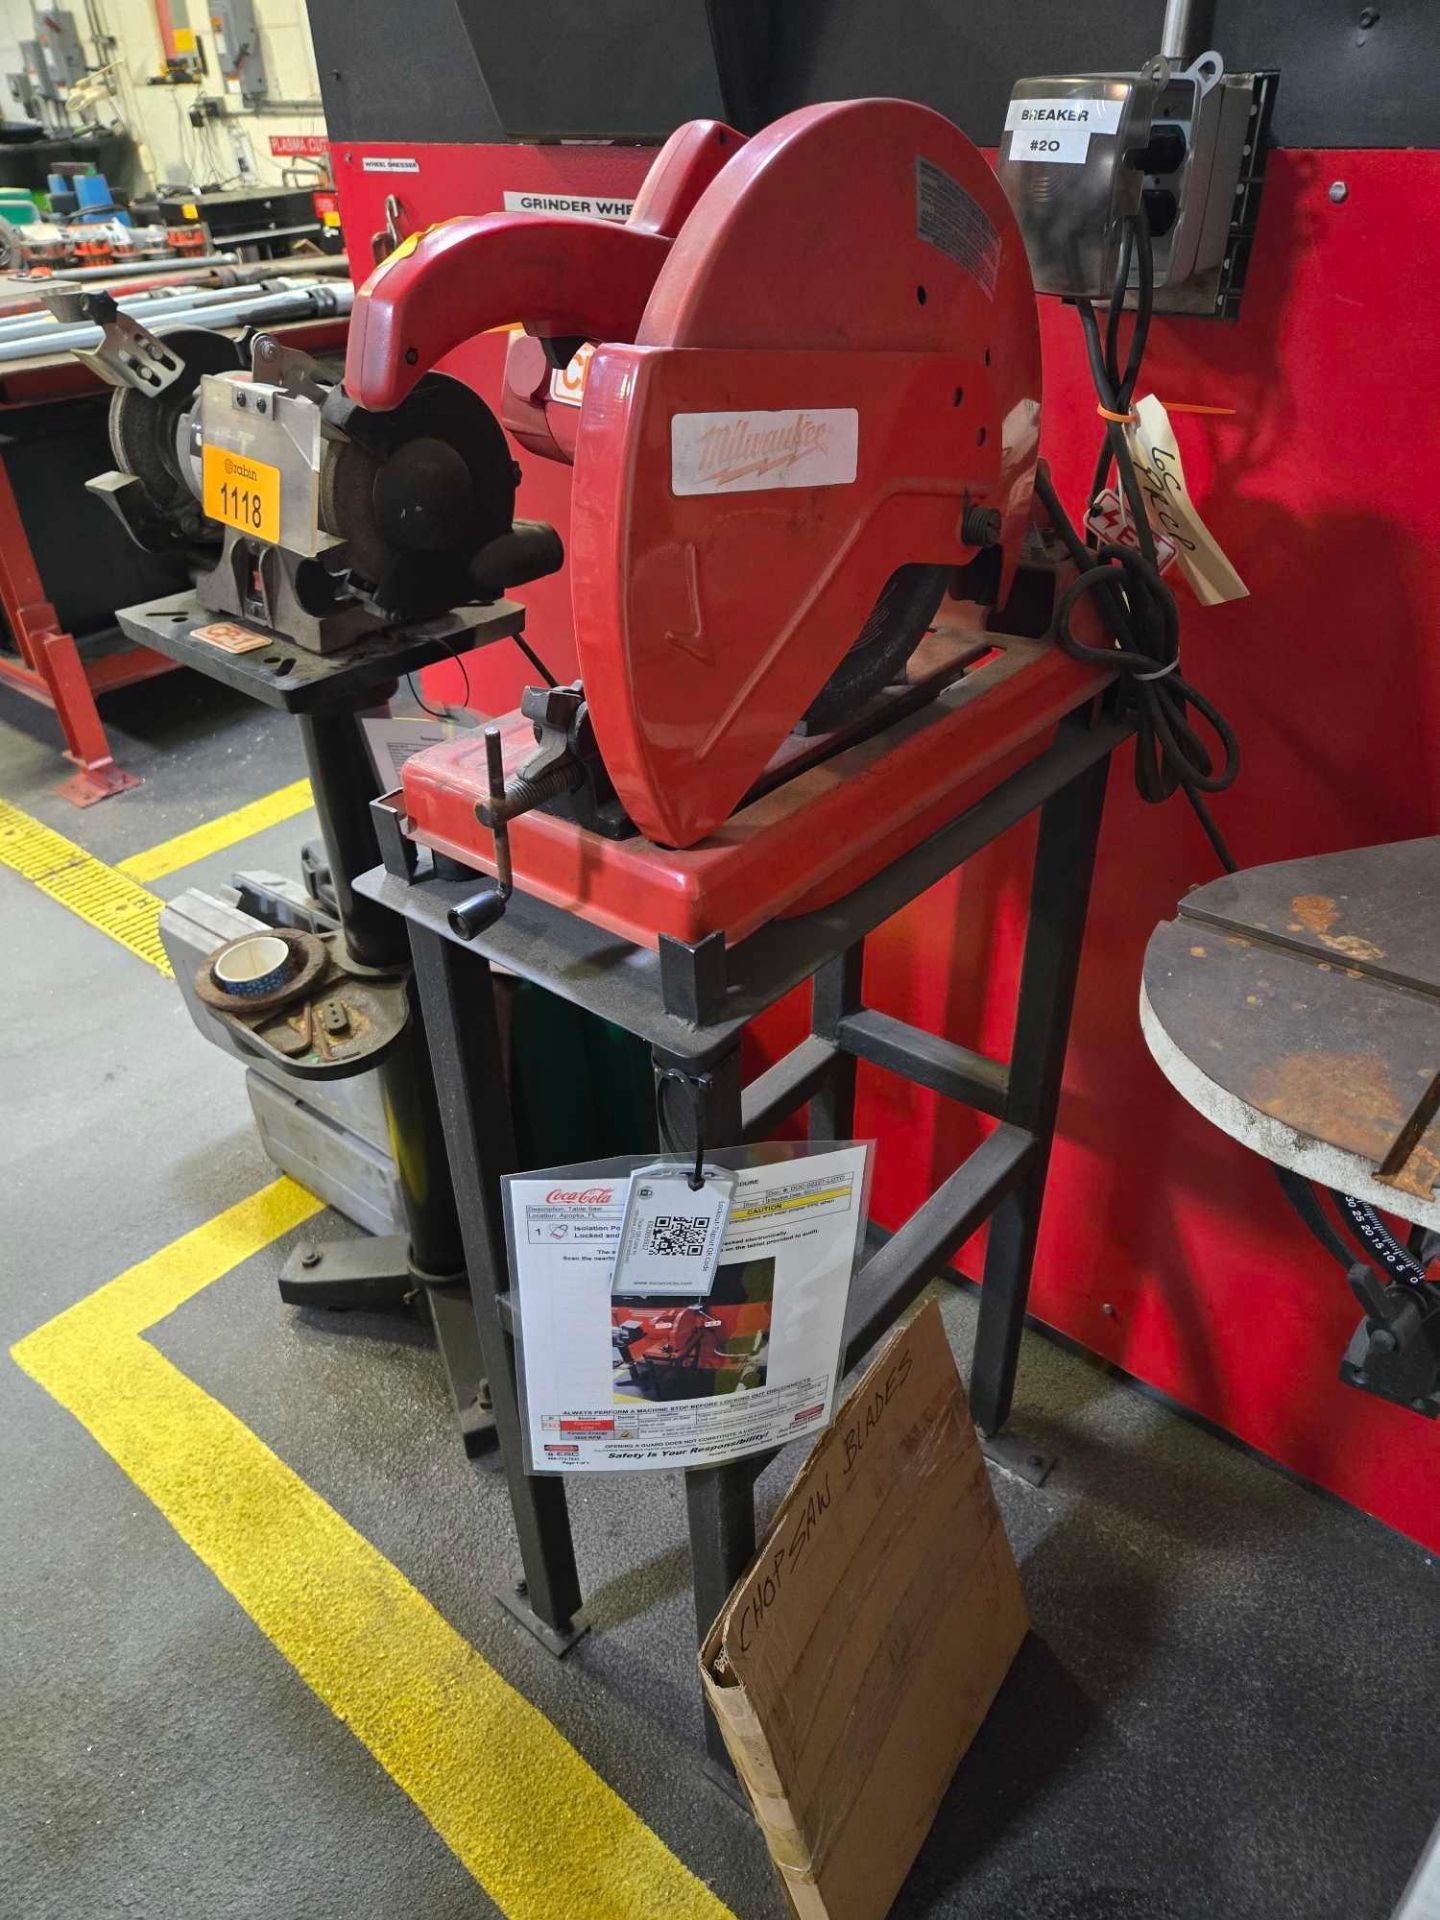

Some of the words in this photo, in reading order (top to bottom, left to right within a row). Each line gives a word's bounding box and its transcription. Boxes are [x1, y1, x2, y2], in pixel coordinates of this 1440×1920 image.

[1021, 109, 1089, 121] BREAKER
[1030, 140, 1060, 151] #20
[365, 161, 386, 169] WHEEL
[520, 197, 591, 213] GRINDER
[220, 482, 261, 528] 1118
[546, 1188, 614, 1204] Coca-Cola
[747, 1203, 782, 1216] CAUTION
[535, 1228, 542, 1236] 1
[1352, 1210, 1364, 1222] 25
[1361, 1224, 1374, 1236] 20
[1371, 1238, 1384, 1249] 15
[1383, 1251, 1396, 1262] 10
[842, 1348, 914, 1476] BLADES
[608, 1451, 645, 1460] Safety
[661, 1449, 687, 1457] Your
[689, 1430, 770, 1455] Responsibility!
